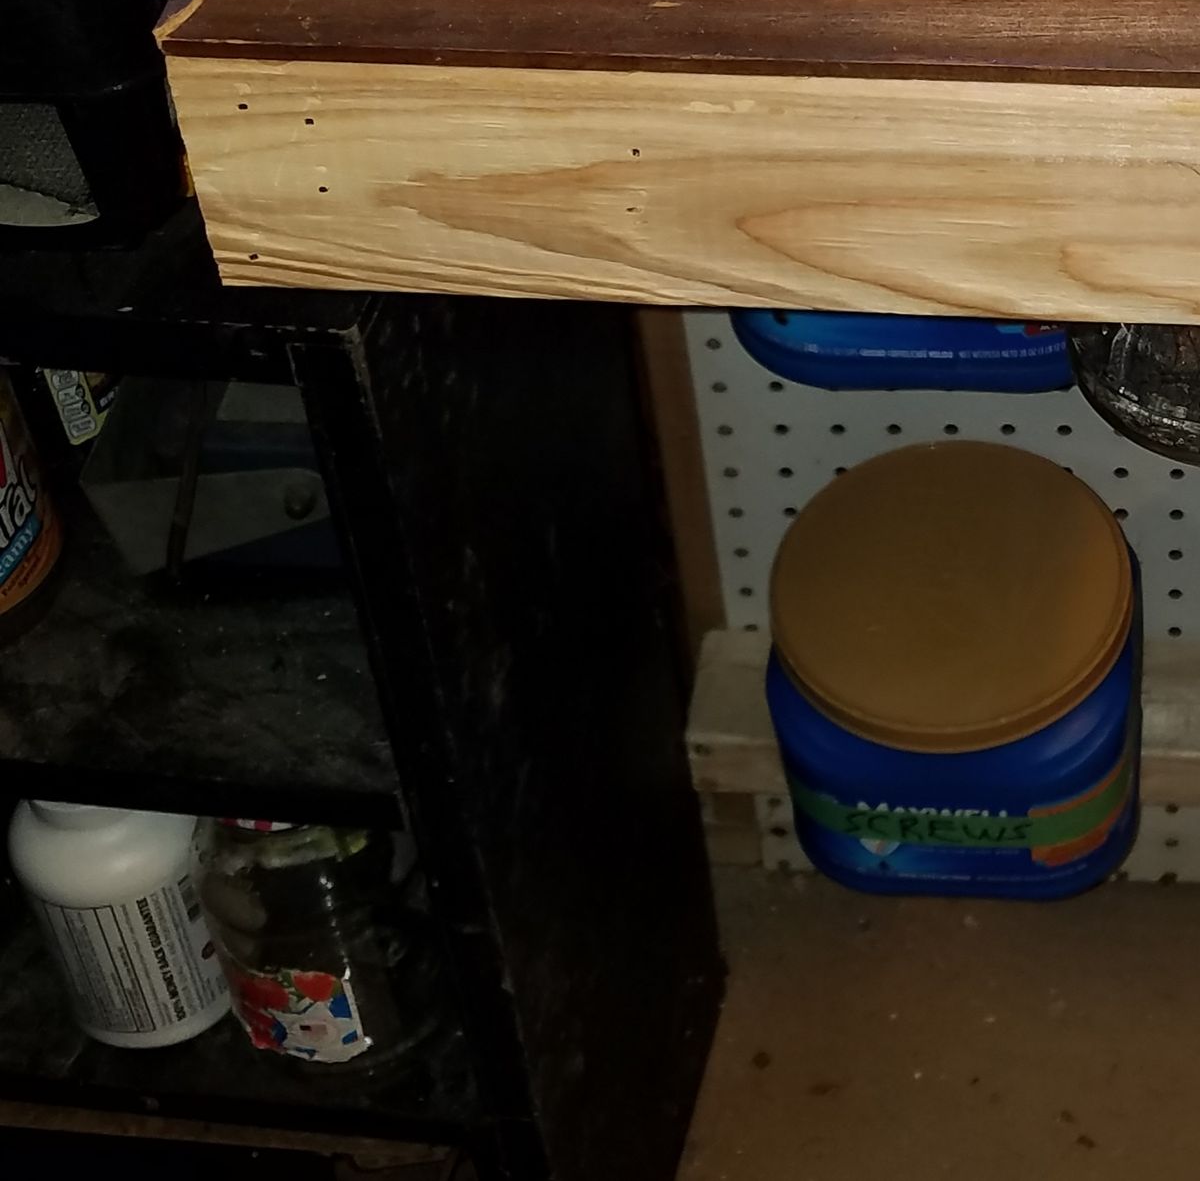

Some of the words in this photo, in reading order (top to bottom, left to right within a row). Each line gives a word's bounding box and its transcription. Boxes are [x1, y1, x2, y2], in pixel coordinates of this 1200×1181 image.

[845, 809, 1034, 844] SCREWS
[136, 897, 162, 949] GUARANTEE
[152, 946, 170, 970] BACK
[162, 970, 179, 999] MONEY
